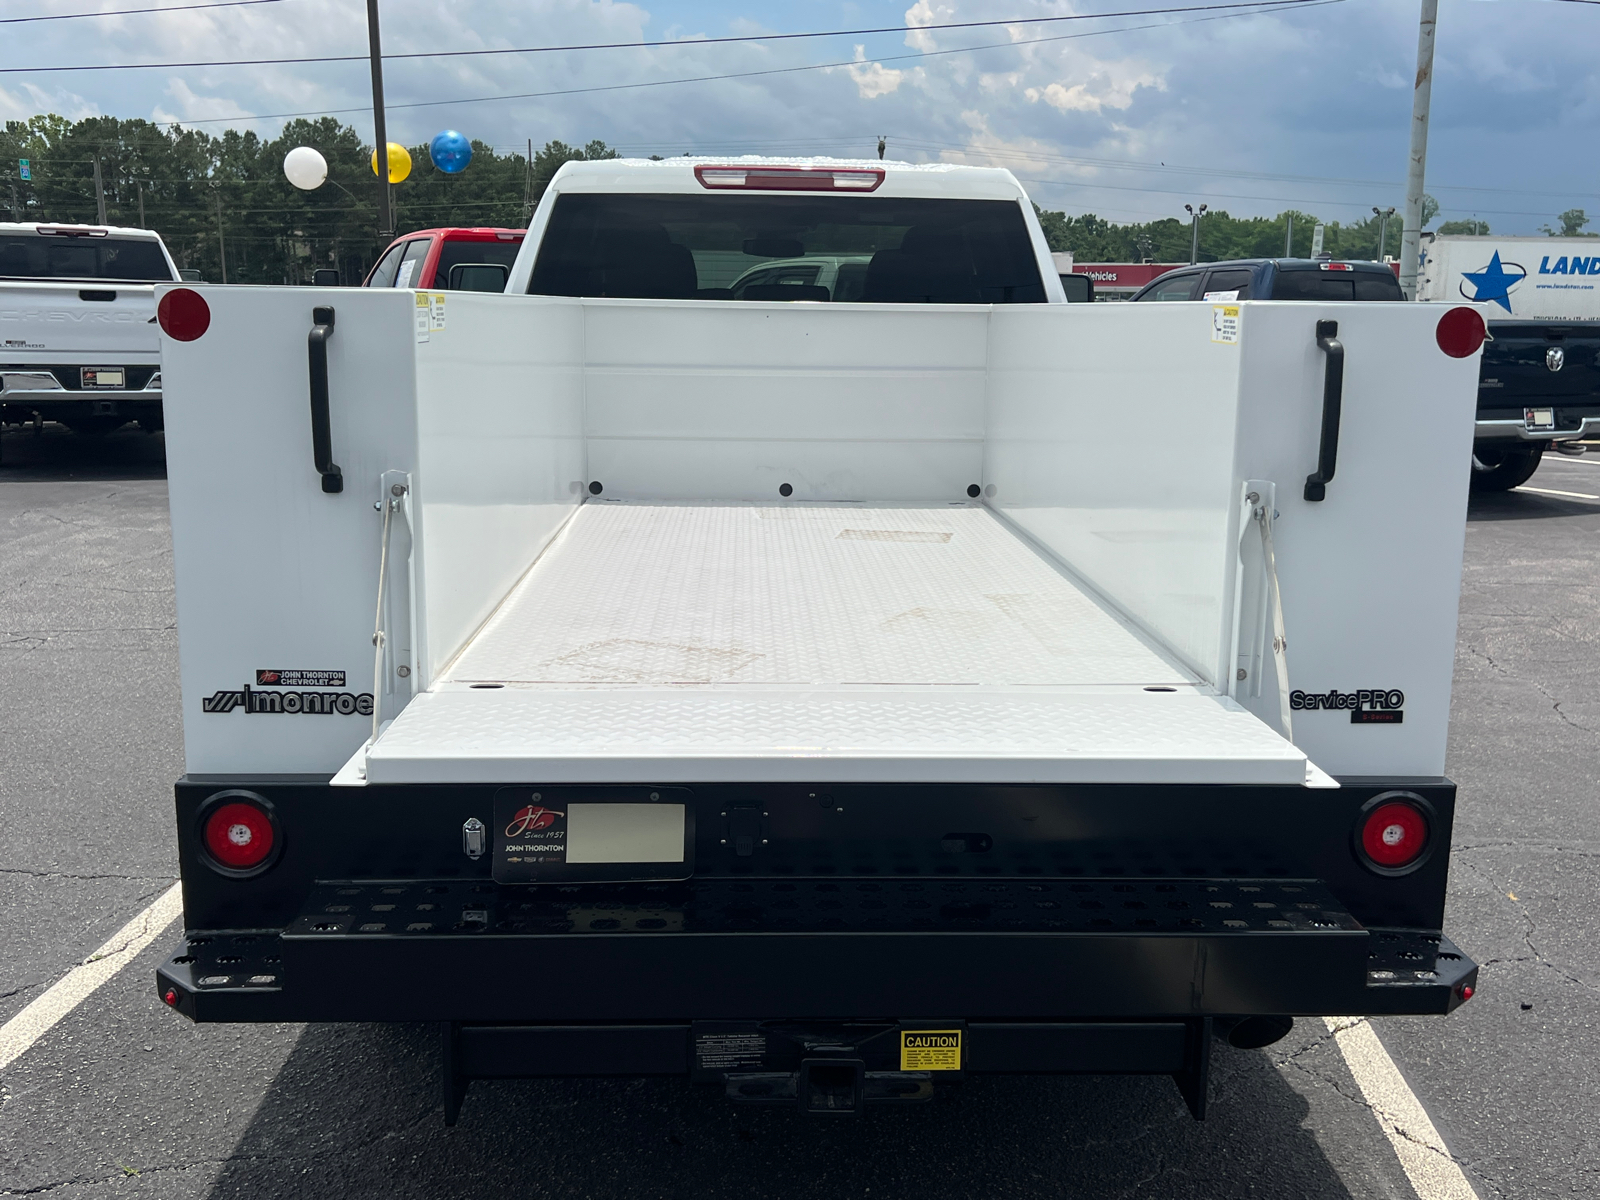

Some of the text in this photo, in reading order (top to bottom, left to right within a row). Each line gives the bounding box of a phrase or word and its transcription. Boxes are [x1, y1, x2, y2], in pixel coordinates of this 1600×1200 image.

[280, 671, 301, 679] JOHN
[1290, 690, 1404, 710] ServicePRO
[524, 831, 564, 839] Since 1957
[906, 1036, 957, 1047] CAUTION
